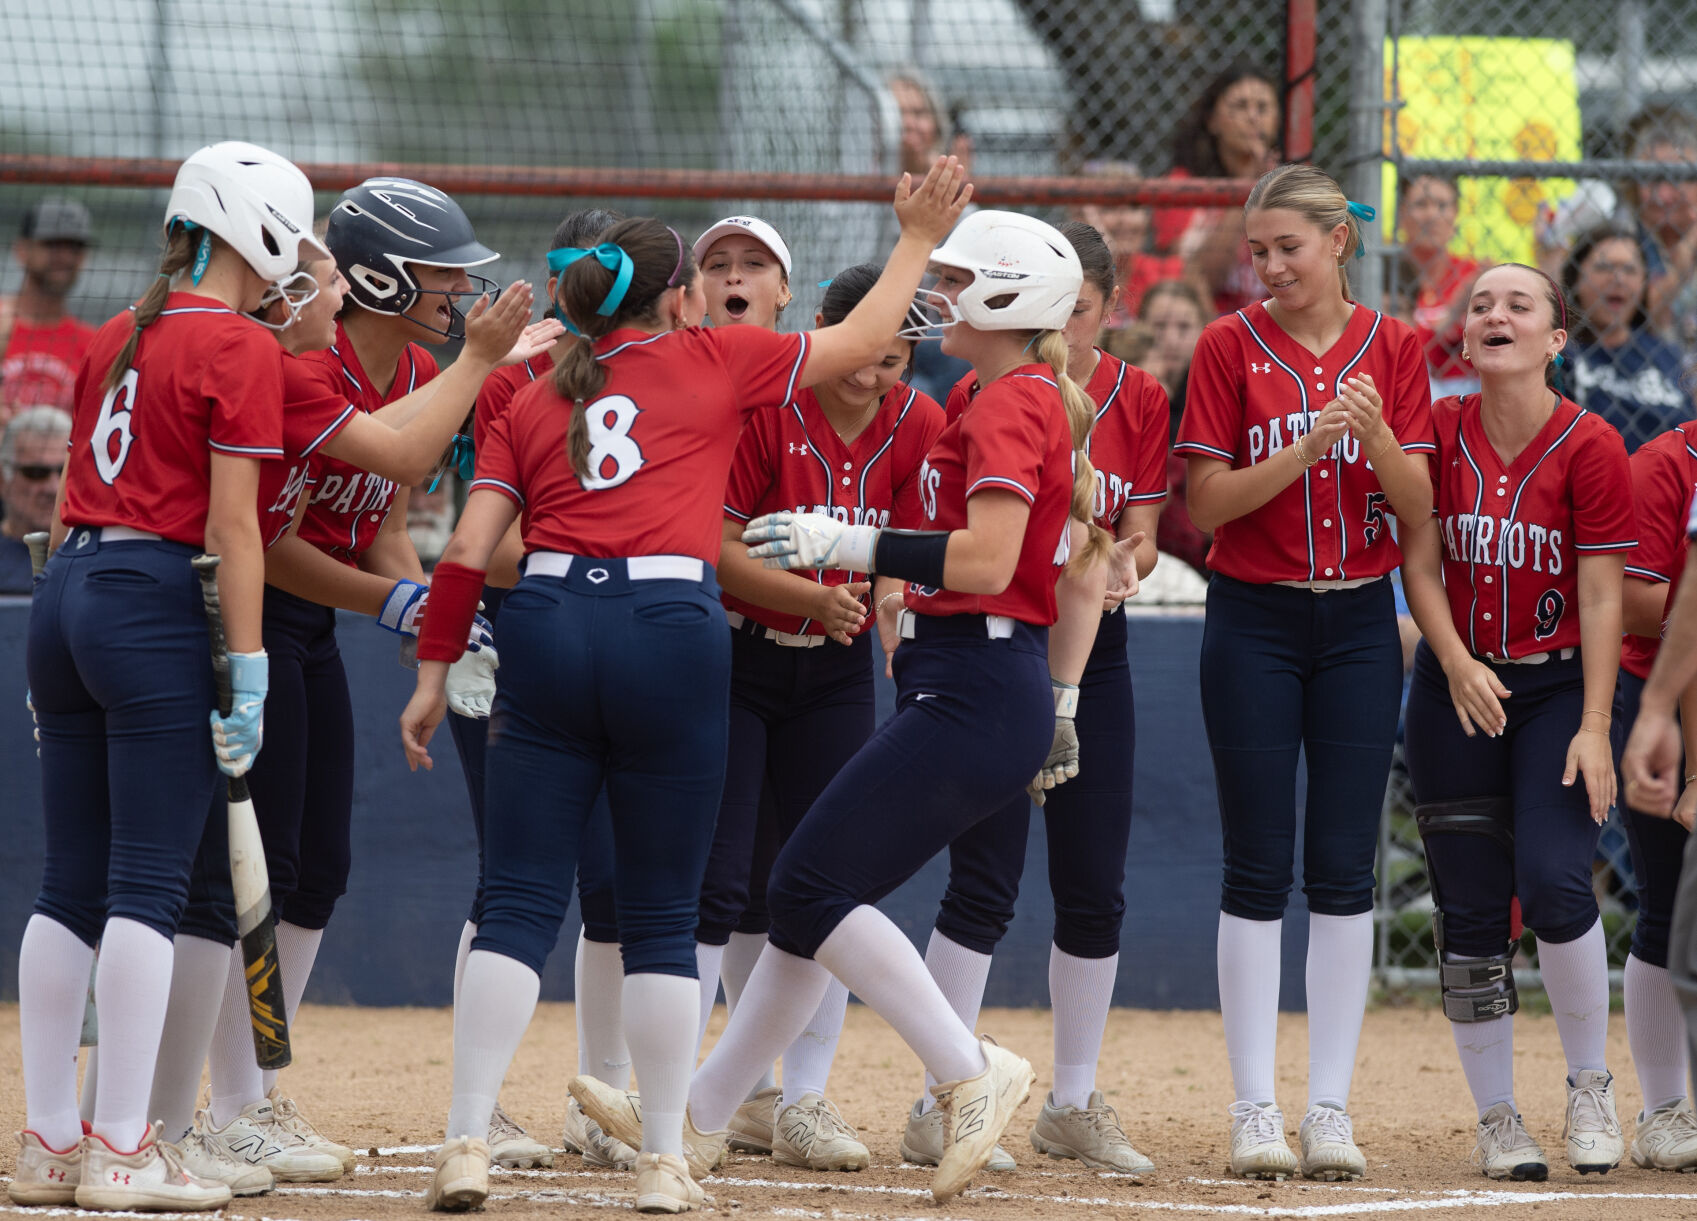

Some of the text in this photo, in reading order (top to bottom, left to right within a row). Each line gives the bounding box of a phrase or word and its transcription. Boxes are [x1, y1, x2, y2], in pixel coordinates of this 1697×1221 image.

[90, 367, 139, 487] 6
[575, 393, 649, 491] 8
[1363, 491, 1386, 549] 5
[1439, 513, 1562, 575] ATRIOTS
[1534, 588, 1566, 641] 9
